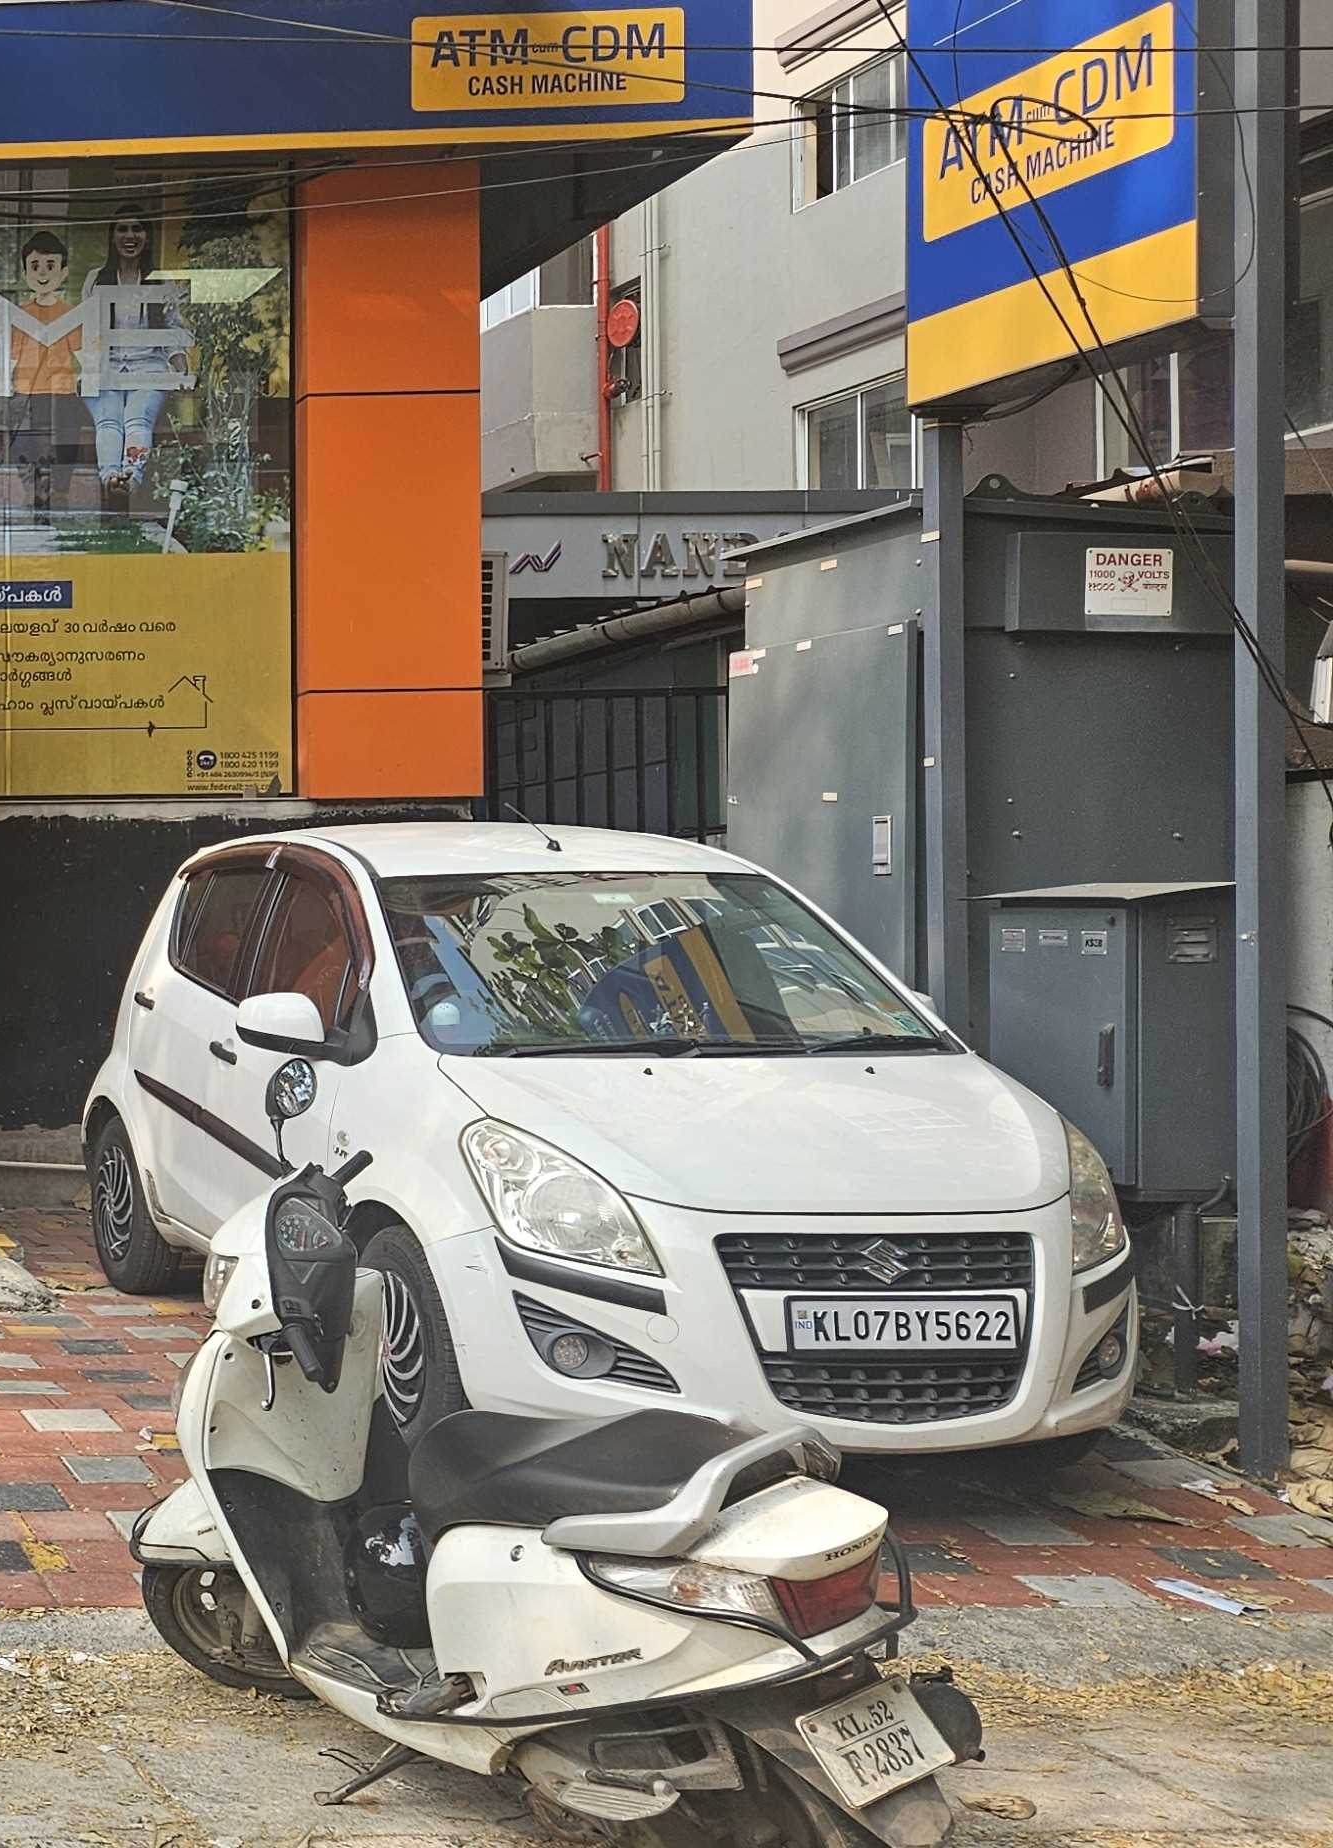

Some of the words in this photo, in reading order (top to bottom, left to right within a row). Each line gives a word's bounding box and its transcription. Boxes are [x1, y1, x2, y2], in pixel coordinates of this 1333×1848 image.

[431, 28, 529, 68] ATM
[562, 23, 665, 63] CDM
[468, 75, 524, 96] CASH
[532, 72, 627, 94] MACHINE
[939, 94, 1024, 180] ATM
[1053, 33, 1153, 125] CDM
[970, 160, 1021, 205] CASH
[1026, 118, 1115, 183] MACHINE
[601, 530, 790, 578] NAND
[1096, 553, 1163, 566] DANGER
[1089, 570, 1116, 579] 11000
[1137, 570, 1170, 580] VOLTS
[64, 622, 80, 633] 30
[813, 1310, 1011, 1341] KL07BY5622
[544, 1647, 644, 1676] AVIATOR
[832, 1699, 895, 1741] KL.52
[841, 1725, 926, 1788] F.2837
